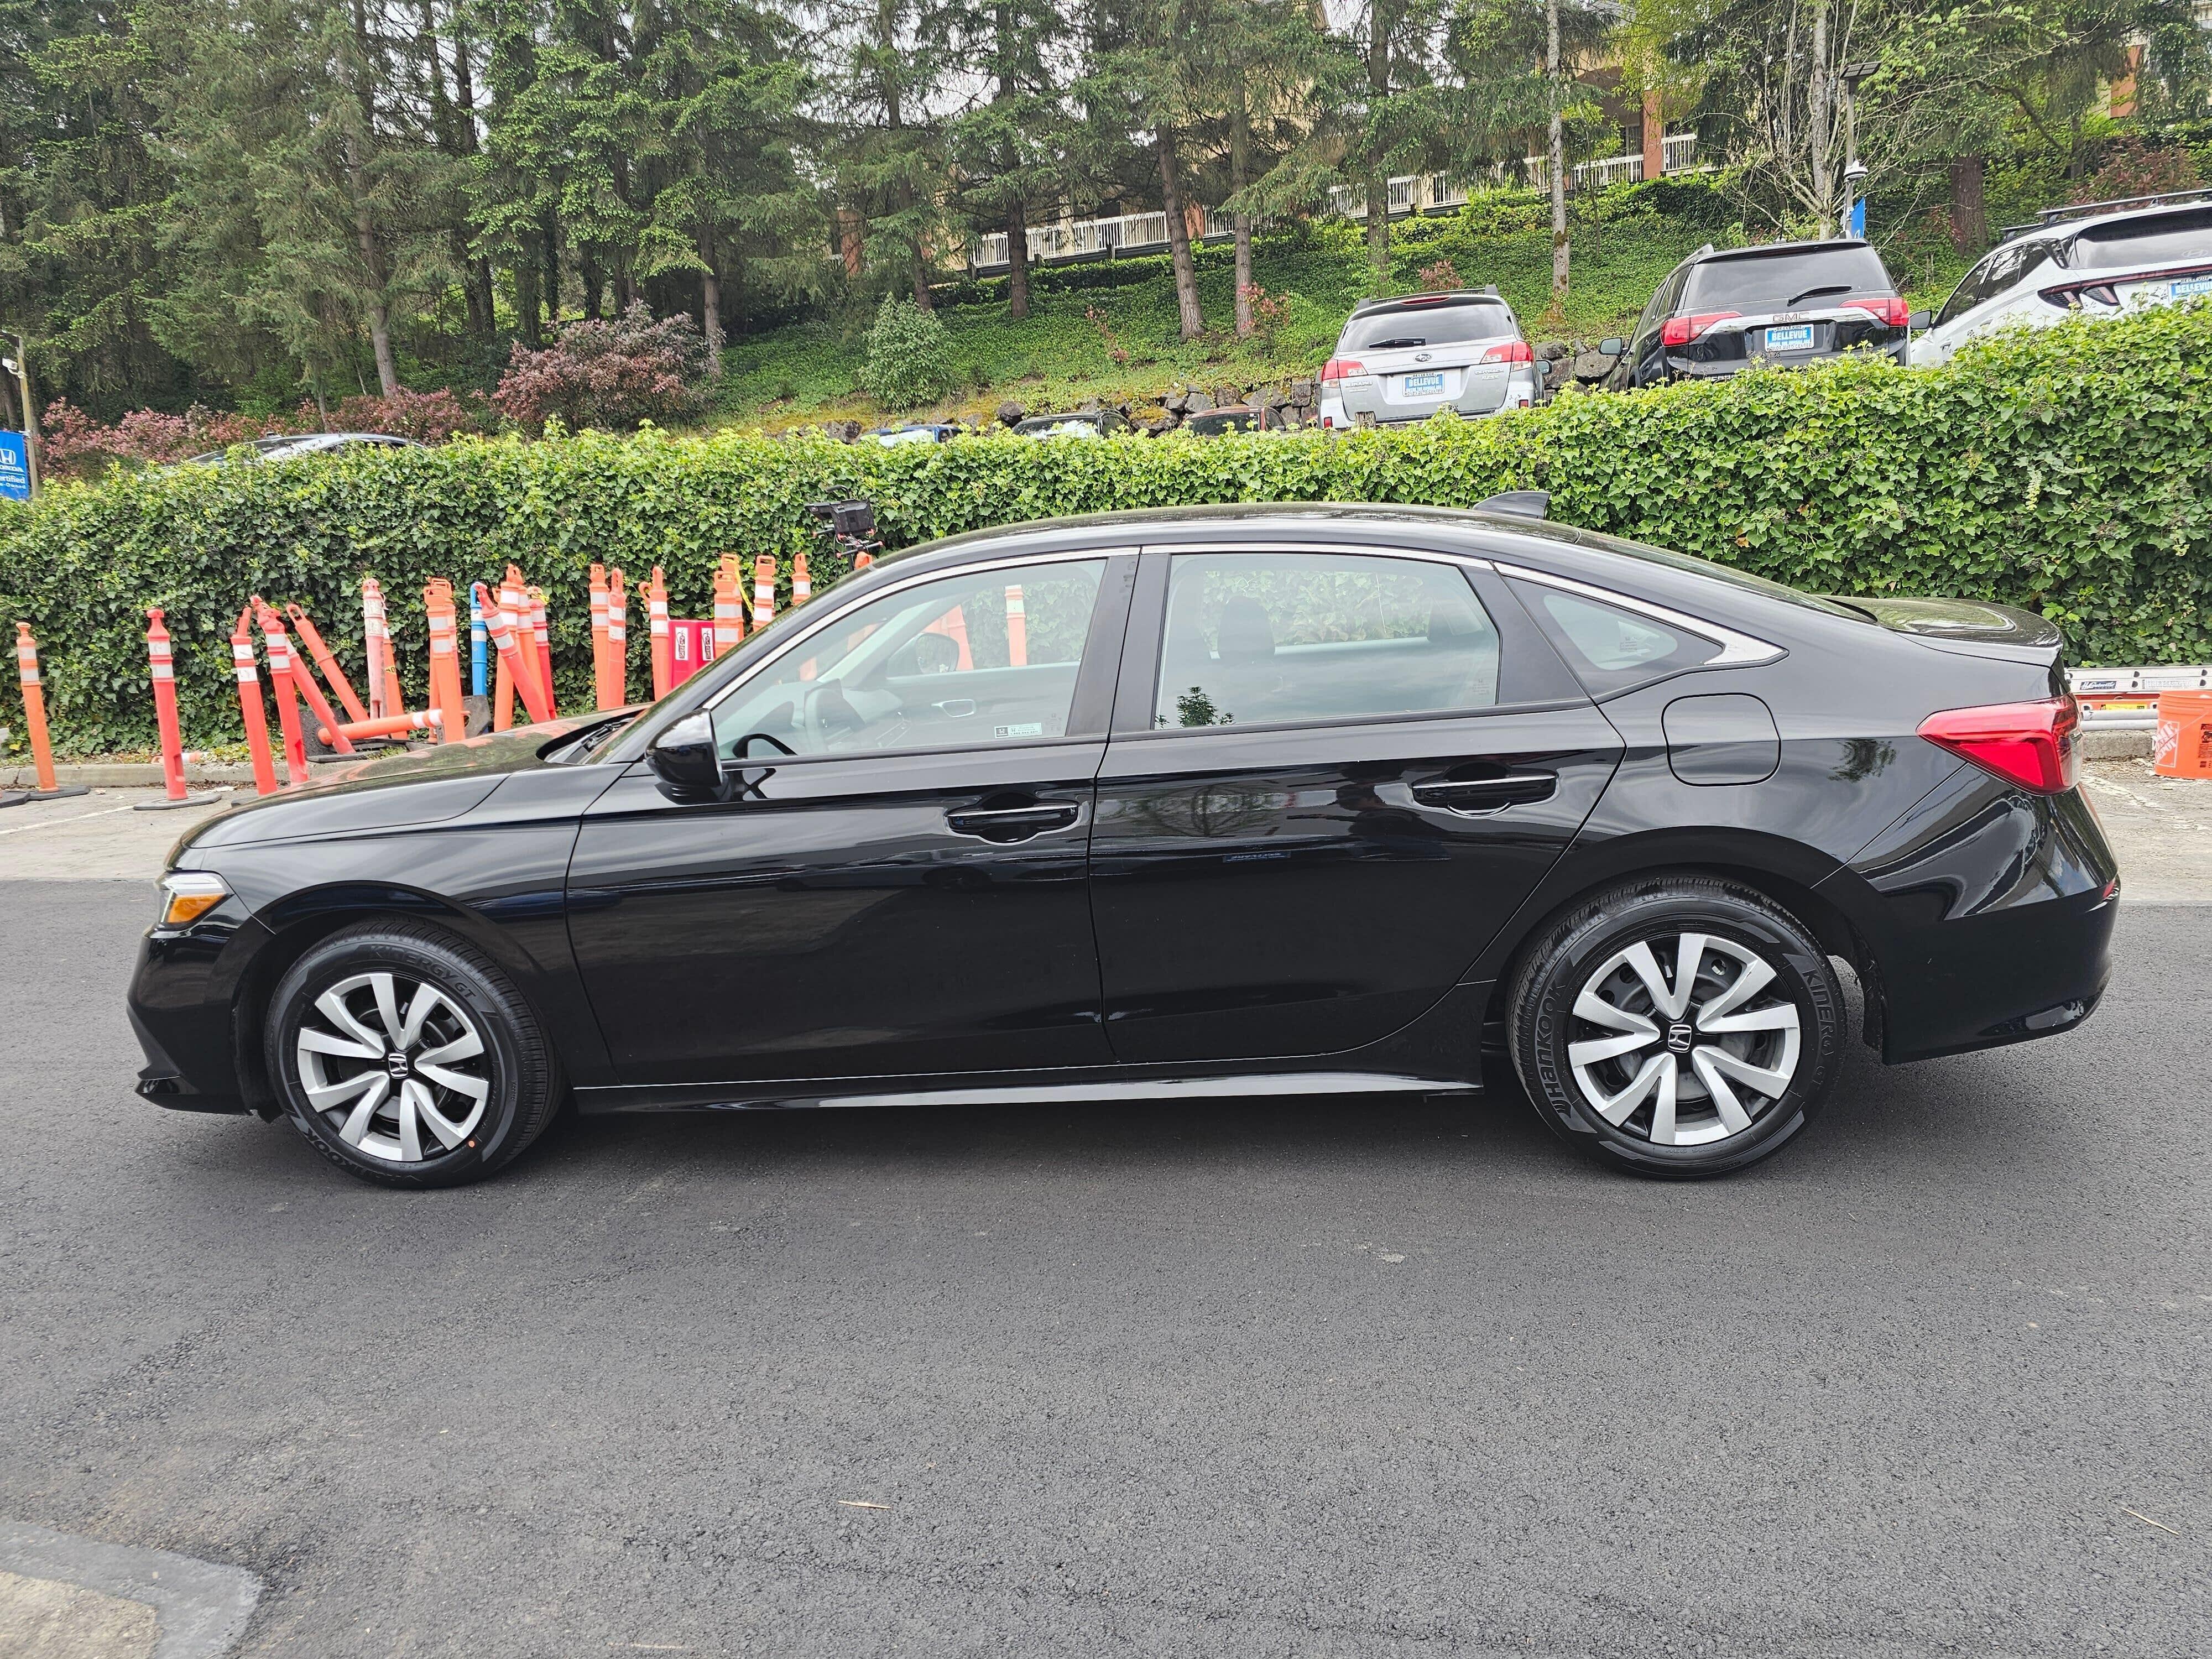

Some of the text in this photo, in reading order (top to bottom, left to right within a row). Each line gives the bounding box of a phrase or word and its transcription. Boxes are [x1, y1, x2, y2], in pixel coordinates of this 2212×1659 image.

[1773, 312, 1809, 322] GMC
[1771, 330, 1808, 341] BELLEVUE
[1408, 377, 1439, 387] BELLEVUE
[0, 475, 25, 484] ertified
[454, 982, 477, 999] GT
